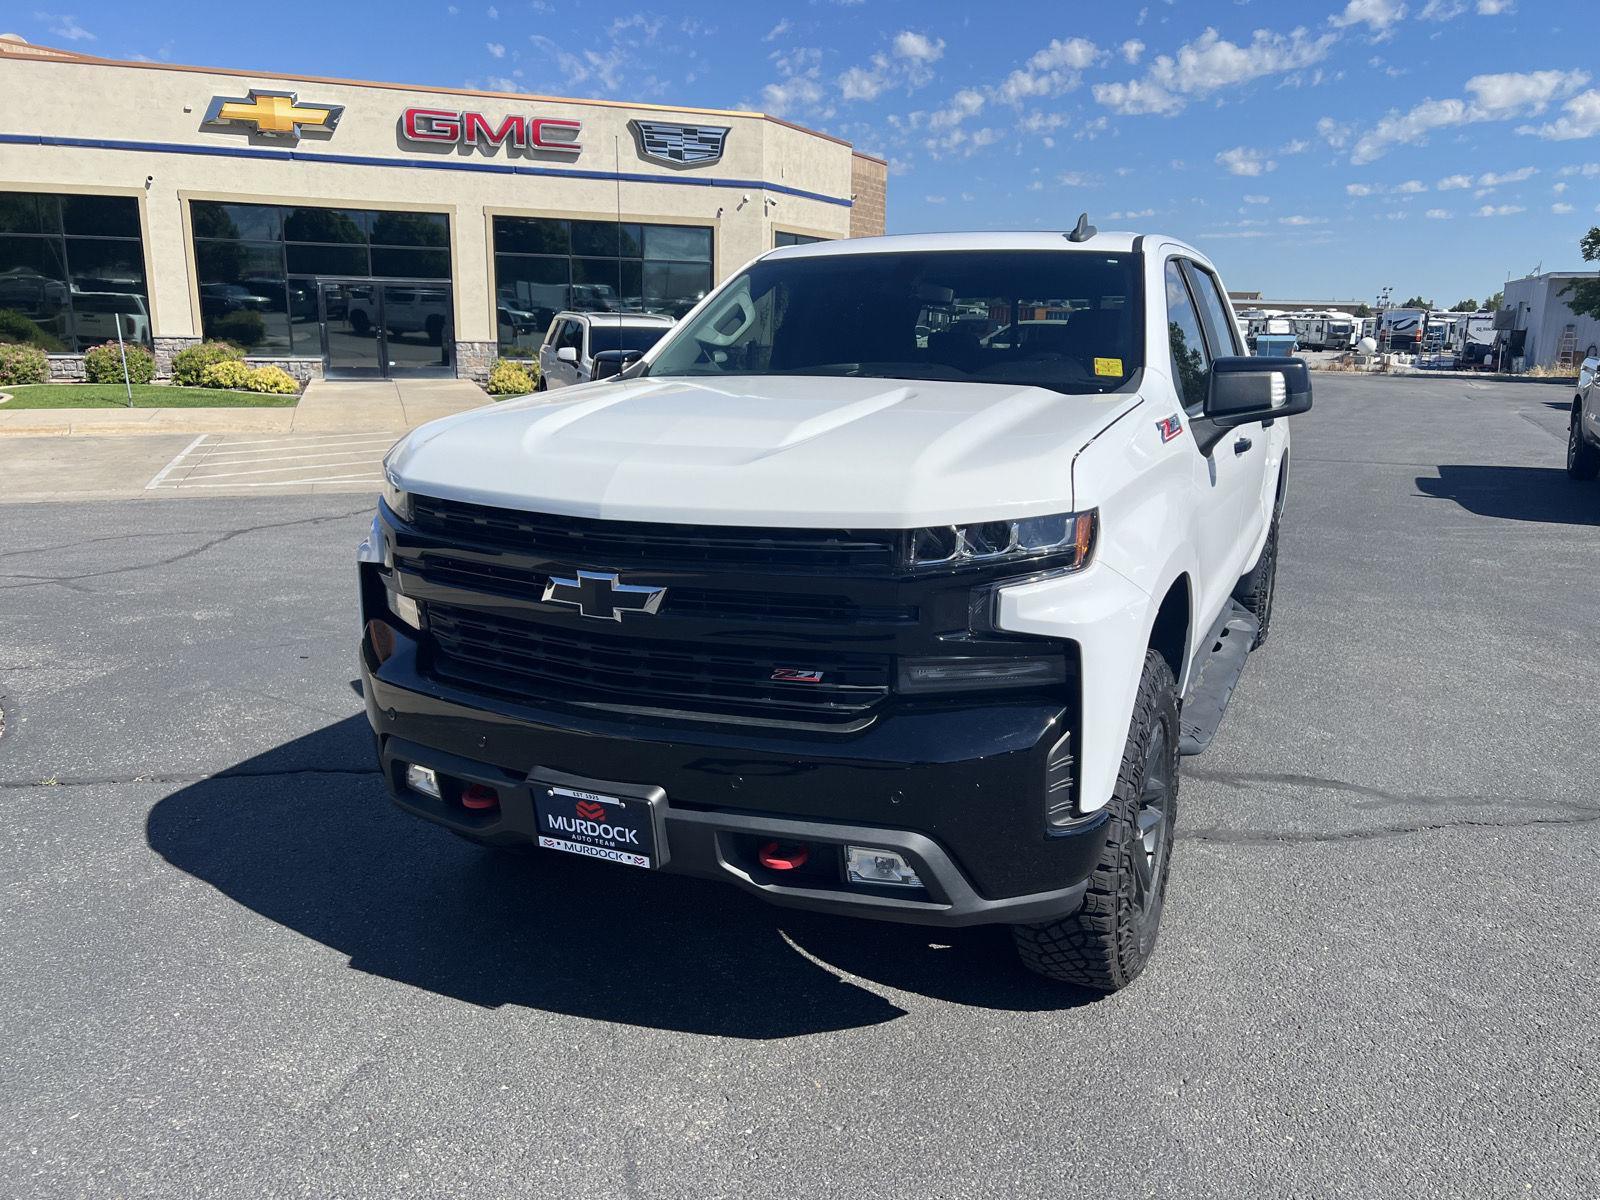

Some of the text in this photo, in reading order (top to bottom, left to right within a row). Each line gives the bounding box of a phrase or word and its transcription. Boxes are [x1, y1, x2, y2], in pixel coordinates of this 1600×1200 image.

[402, 107, 582, 152] GMC
[547, 814, 639, 845] MURDOCK
[571, 833, 616, 848] AUTO TEAM
[564, 842, 624, 862] MURDOCK
